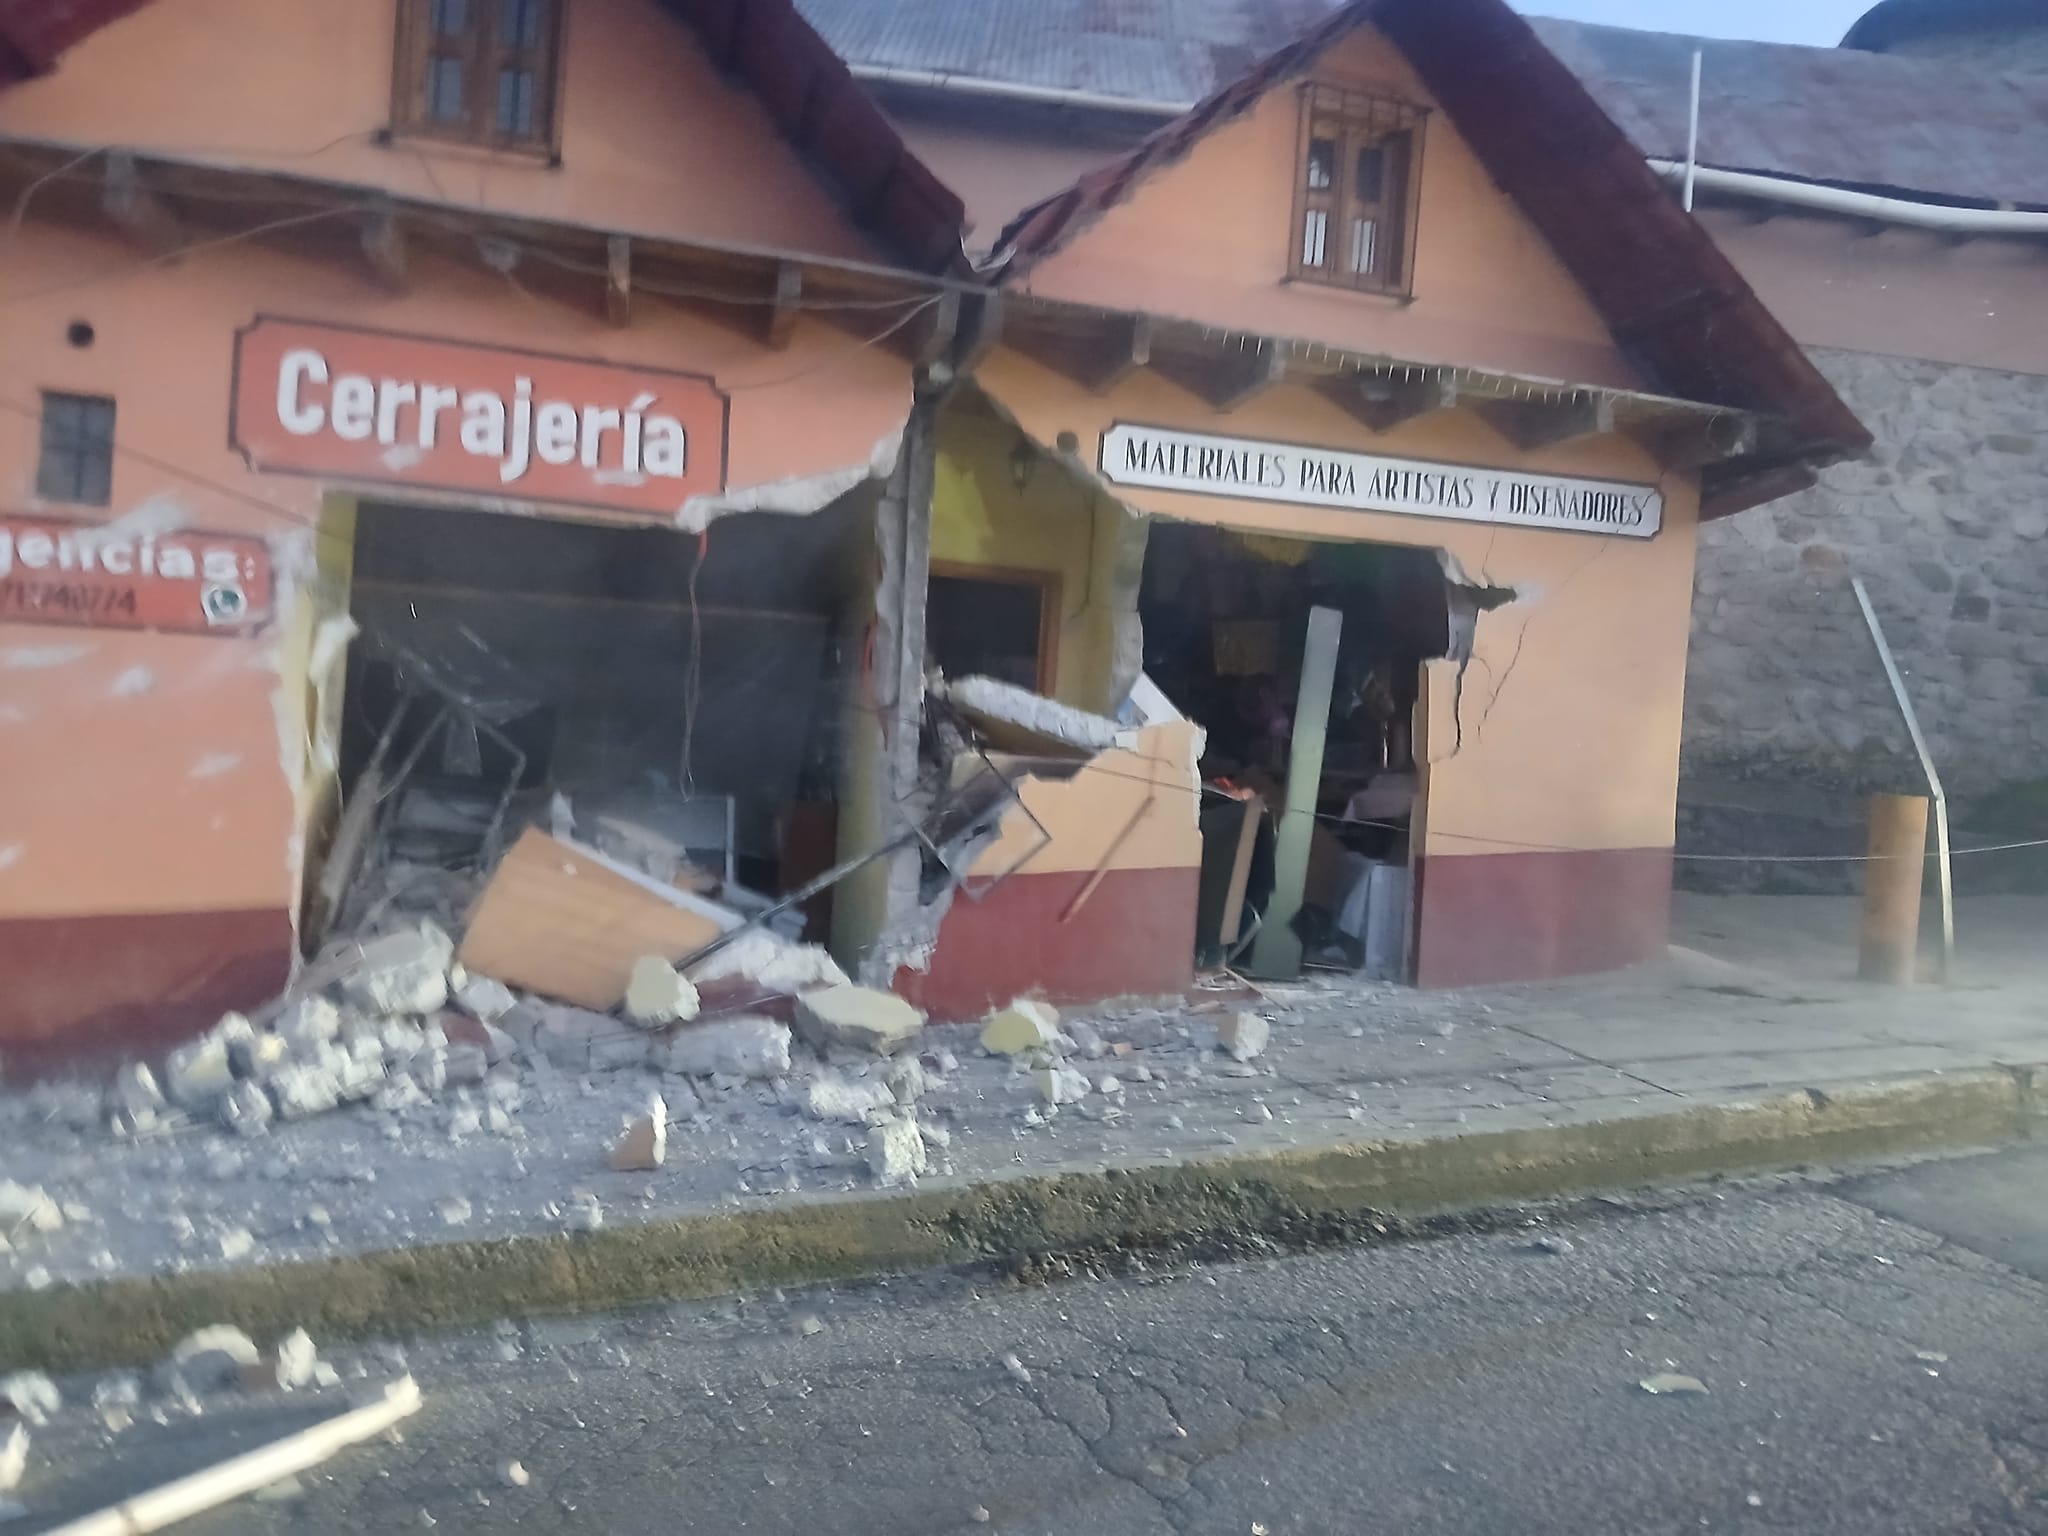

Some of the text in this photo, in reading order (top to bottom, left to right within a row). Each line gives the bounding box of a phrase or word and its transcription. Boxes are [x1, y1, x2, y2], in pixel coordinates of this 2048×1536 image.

[276, 348, 686, 483] Cerrajería
[1125, 437, 1286, 489] MATERIALES
[1299, 458, 1356, 496] PARA
[1368, 466, 1474, 509] ARTISTAS
[1487, 479, 1500, 513] Y
